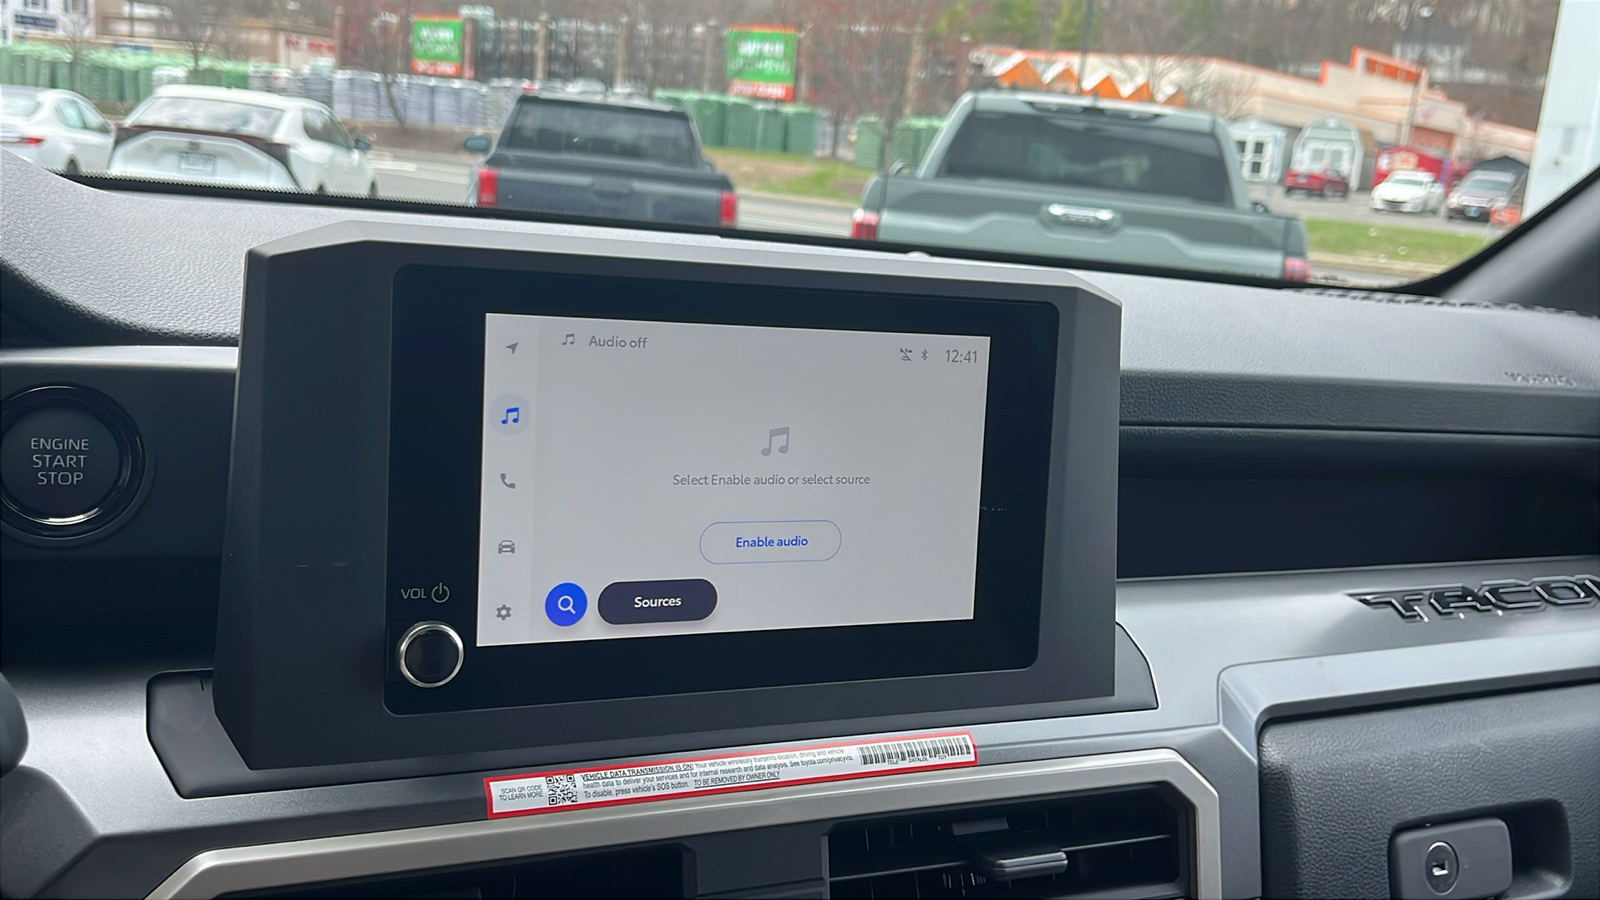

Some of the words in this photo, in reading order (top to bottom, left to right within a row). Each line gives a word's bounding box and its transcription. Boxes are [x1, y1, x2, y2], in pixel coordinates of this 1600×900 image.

[588, 335, 627, 348] Audio
[629, 337, 648, 349] off
[945, 349, 978, 364] 12:41
[30, 438, 89, 450] ENGINE
[32, 454, 87, 468] START
[38, 472, 84, 485] STOP
[672, 475, 708, 486] Select
[711, 474, 750, 486] Enable
[753, 474, 786, 485] audio
[787, 476, 800, 484] or
[802, 474, 833, 484] select
[835, 476, 870, 484] source
[736, 536, 774, 548] Enable
[776, 536, 808, 546] audio
[400, 587, 426, 600] VOL
[634, 595, 682, 608] Sources
[581, 772, 608, 780] VEHICLE
[610, 770, 626, 778] DATA
[628, 766, 674, 776] TRANSMISSION
[728, 757, 752, 765] wirelessly
[753, 755, 776, 763] transmits
[583, 781, 600, 789] health
[602, 780, 614, 788] data
[623, 777, 641, 786] deliver
[642, 776, 654, 784] your
[656, 773, 678, 782] services
[720, 766, 742, 774] research
[790, 760, 800, 768] See
[501, 786, 516, 794] SCAN
[526, 784, 542, 792] CODE
[584, 790, 591, 798] To
[592, 789, 614, 798] disable,
[616, 788, 630, 796] press
[656, 782, 670, 790] SOS
[671, 781, 689, 790] button.
[702, 778, 710, 786] BE
[711, 776, 738, 784] REMOVED
[738, 774, 746, 782] BY
[746, 772, 766, 780] OWNER
[766, 770, 780, 778] ONLY
[508, 792, 526, 800] LEARN
